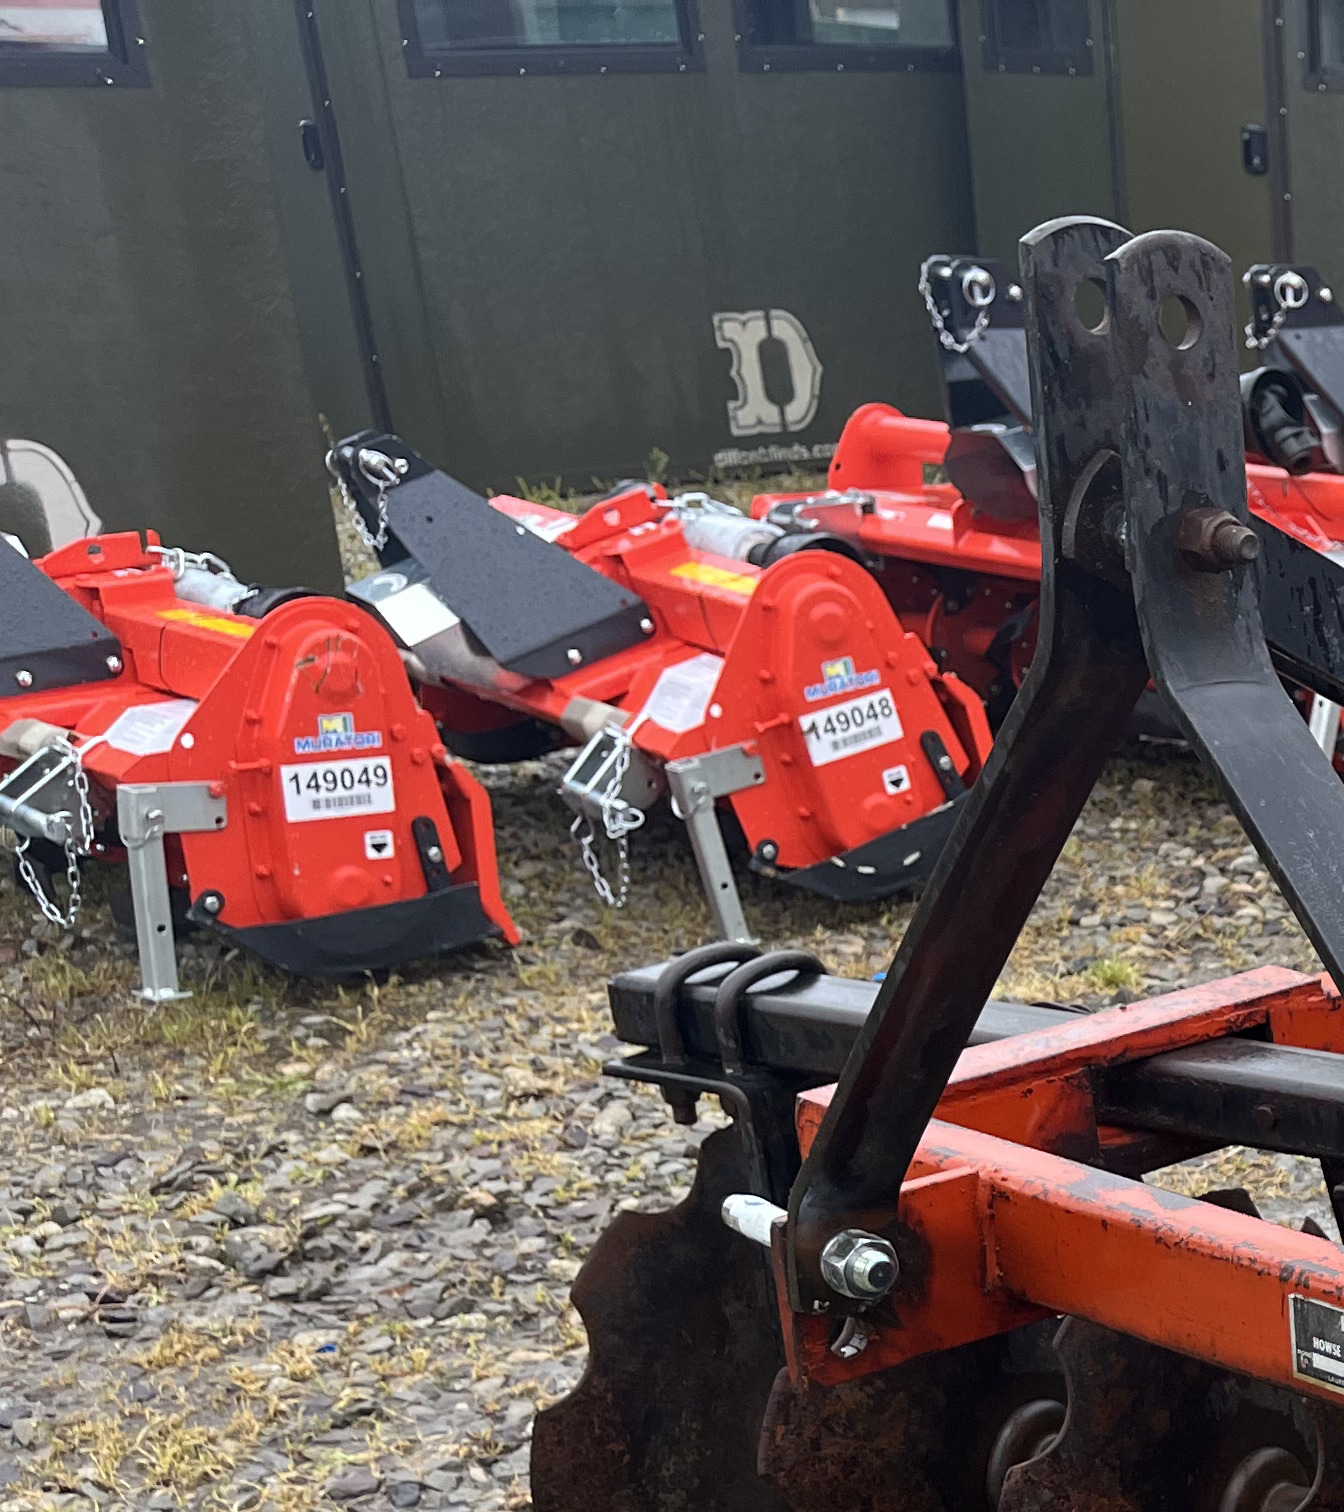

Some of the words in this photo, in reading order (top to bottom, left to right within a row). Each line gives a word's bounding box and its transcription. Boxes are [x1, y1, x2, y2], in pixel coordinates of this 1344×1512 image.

[804, 696, 892, 741] 149048
[296, 732, 381, 752] MURATORI
[289, 765, 388, 796] 149049
[1312, 1336, 1341, 1358] HOWSE
